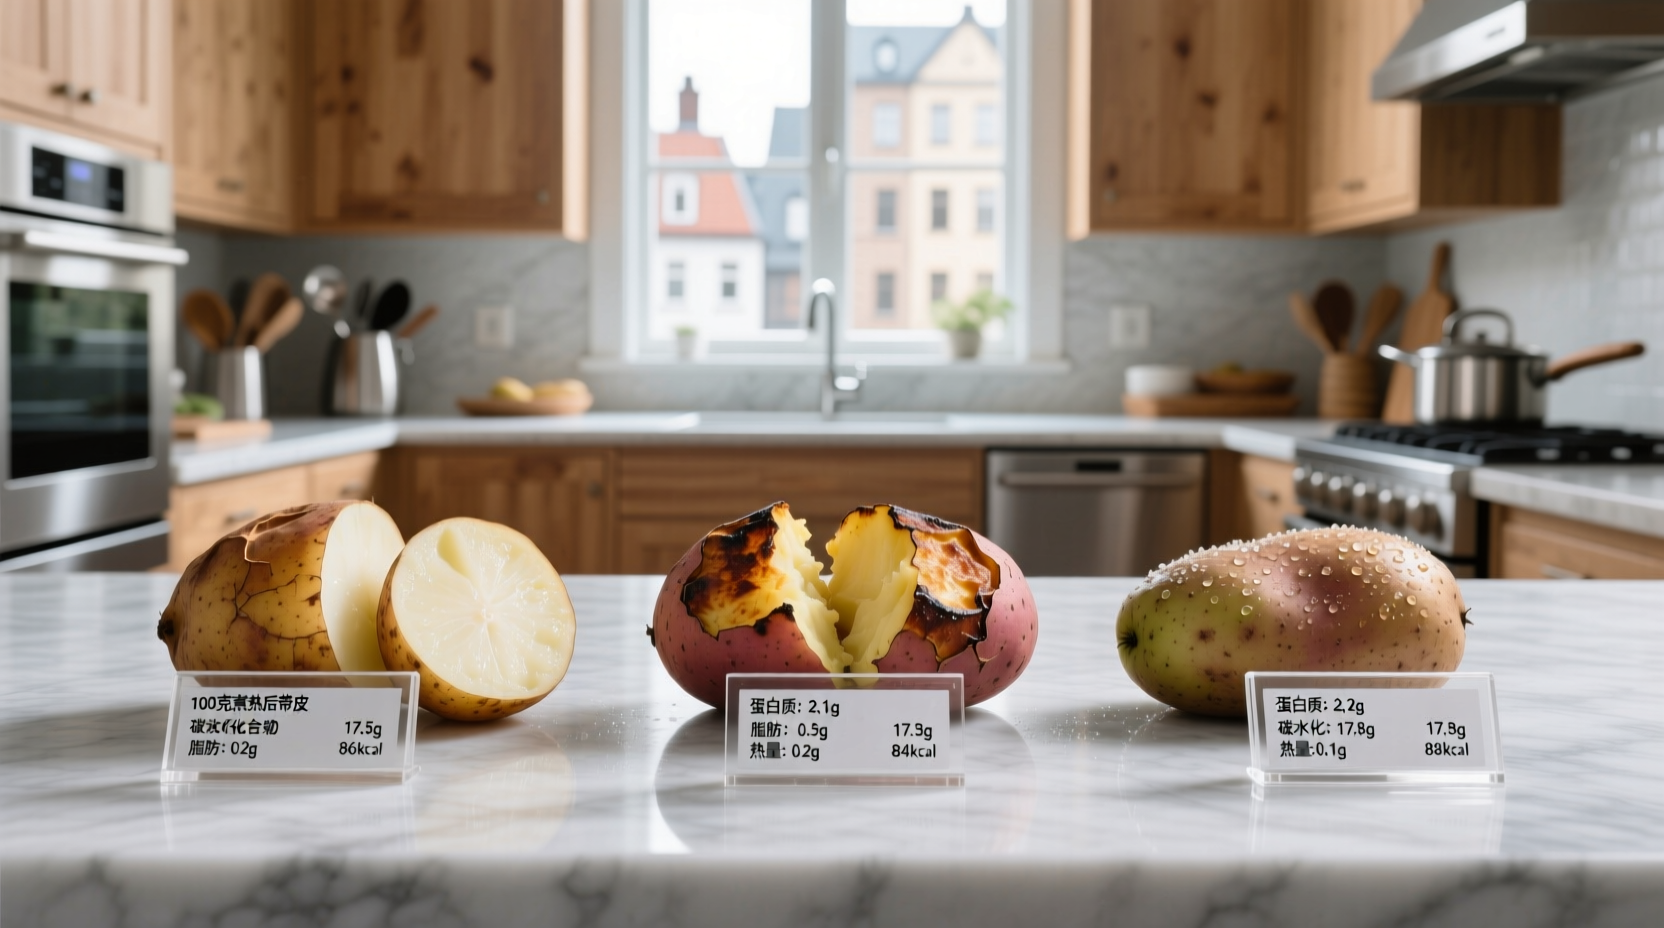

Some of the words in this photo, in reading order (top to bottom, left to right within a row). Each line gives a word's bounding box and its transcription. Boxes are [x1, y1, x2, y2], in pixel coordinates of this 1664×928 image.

[749, 696, 803, 715] 蛋白质:
[1275, 694, 1329, 714] 蛋白质:
[344, 720, 382, 739] 17.5g
[797, 722, 828, 741] 0.5g
[1277, 718, 1331, 737] 碳水化:
[338, 741, 383, 756] 86kcal
[891, 743, 936, 759] 84kcal
[1424, 741, 1469, 757] 88kcal
